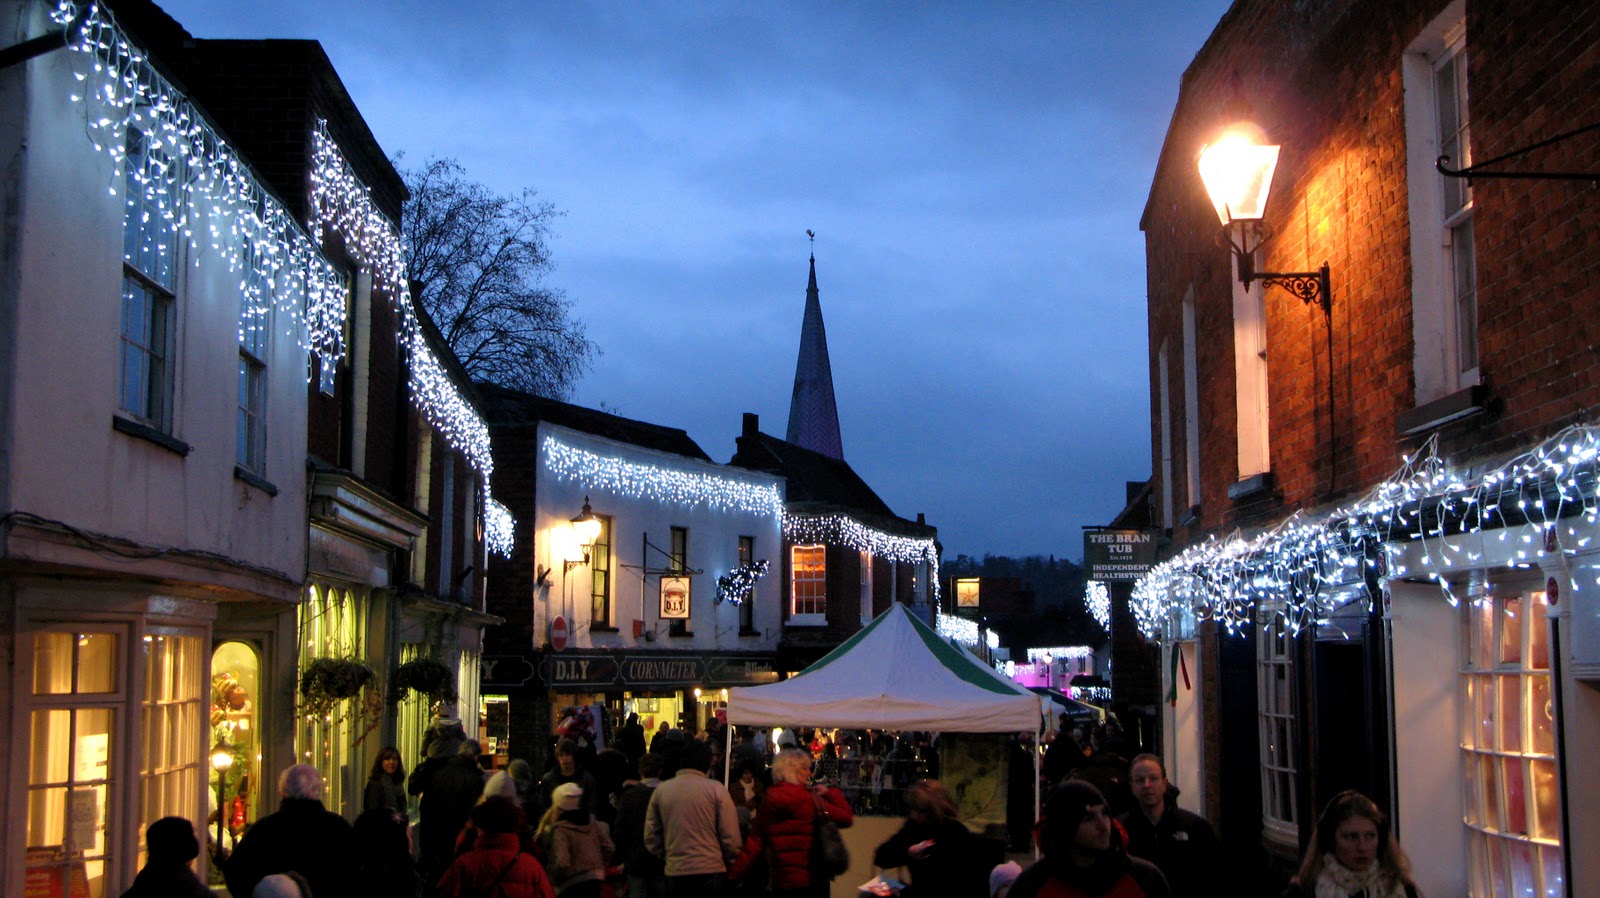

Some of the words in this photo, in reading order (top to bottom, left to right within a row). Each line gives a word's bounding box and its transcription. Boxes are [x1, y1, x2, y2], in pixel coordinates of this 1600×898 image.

[1089, 534, 1113, 543] THE
[1116, 534, 1150, 543] BRAN
[1107, 544, 1133, 553] TUB
[666, 599, 683, 612] D.I.Y
[555, 659, 590, 680] D.I.Y
[629, 661, 697, 680] CORNMETER
